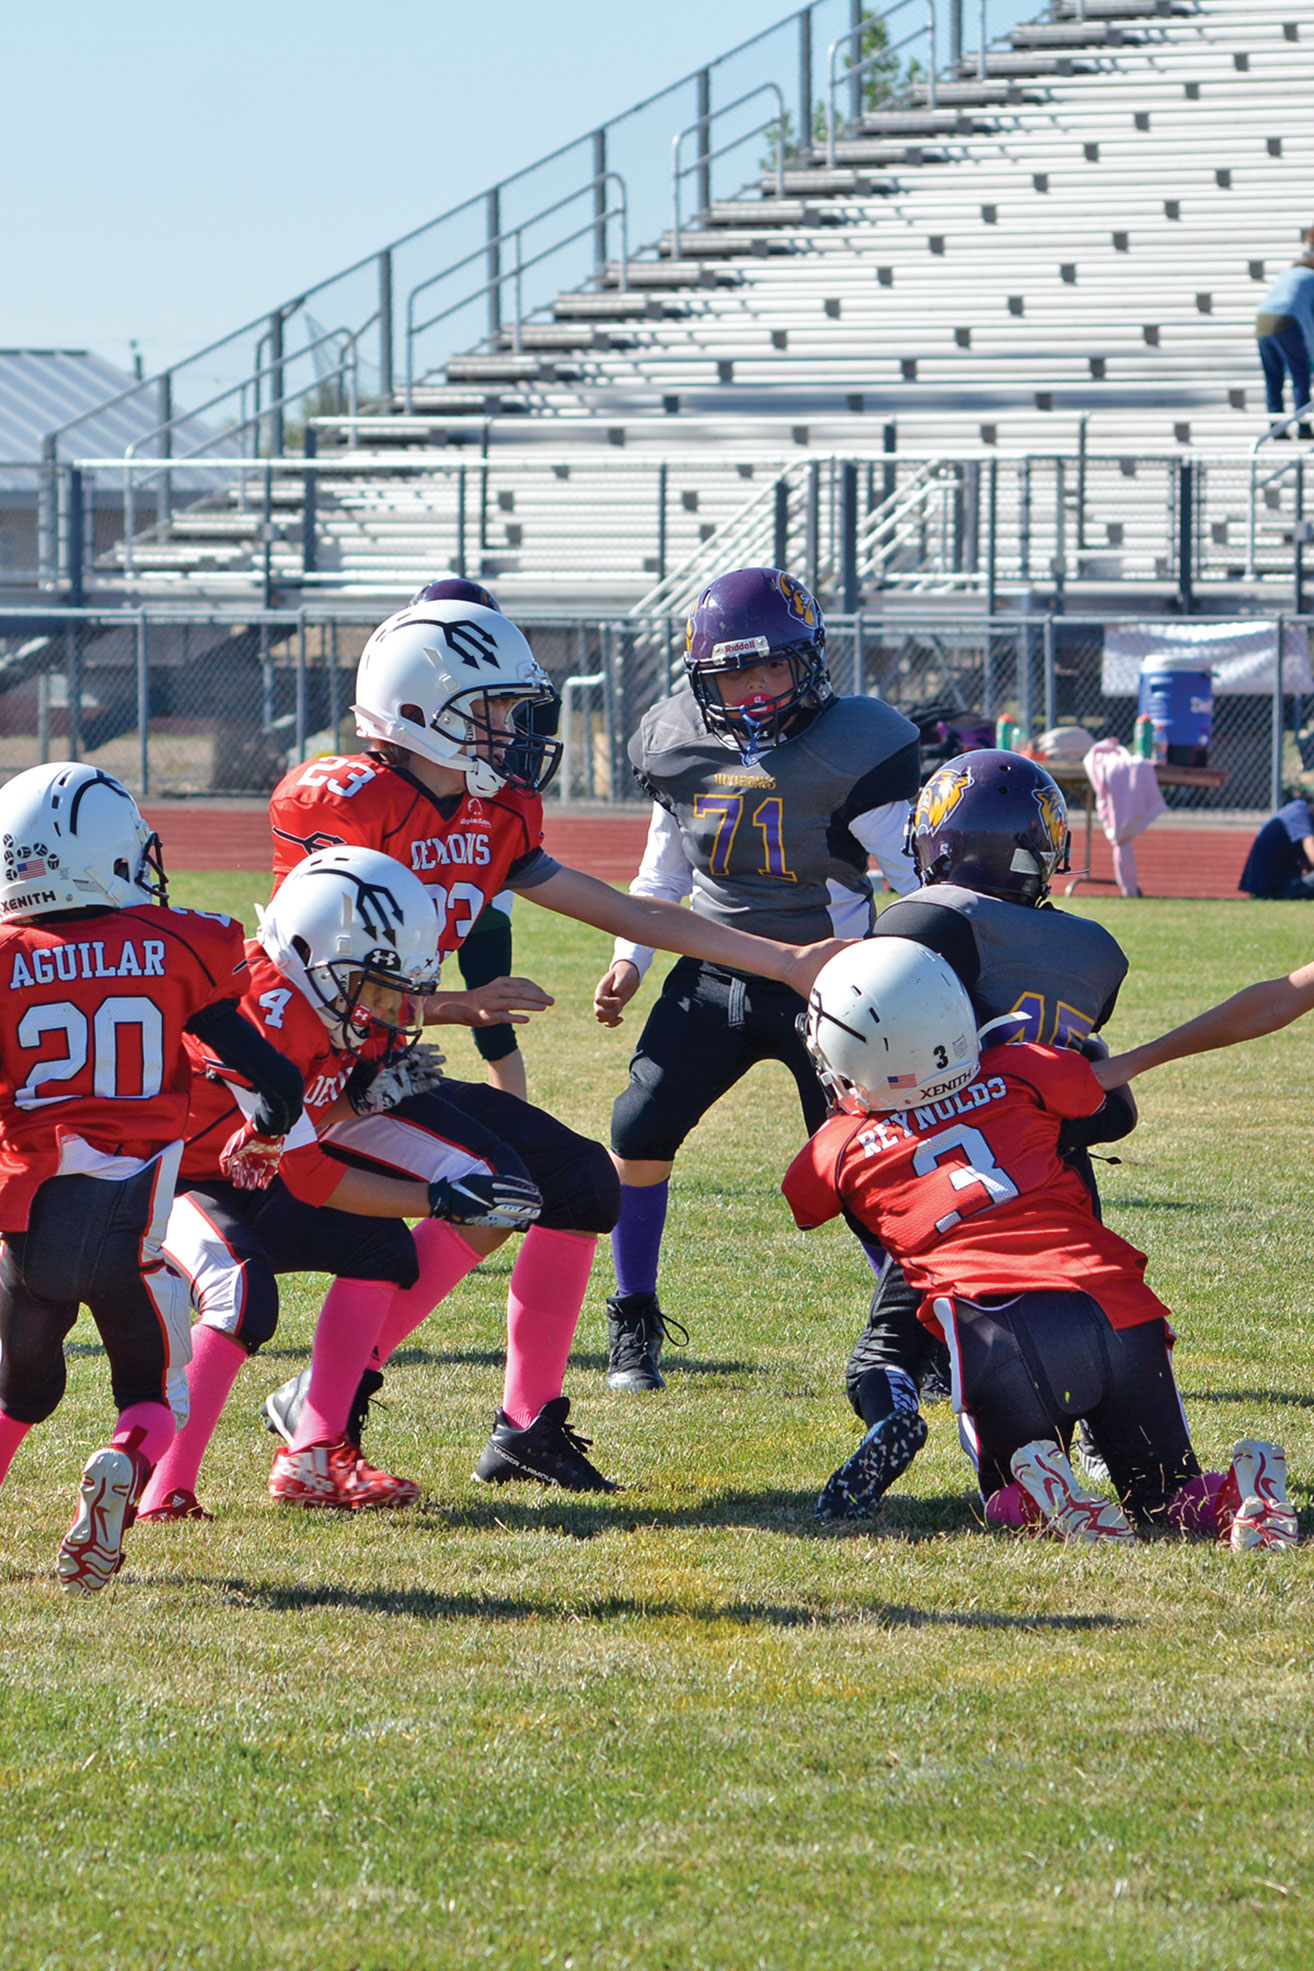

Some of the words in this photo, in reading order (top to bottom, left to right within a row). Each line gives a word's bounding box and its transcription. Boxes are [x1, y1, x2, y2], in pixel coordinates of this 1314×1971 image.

[725, 640, 756, 653] Riddell
[296, 756, 376, 798] 23
[411, 832, 491, 870] DEMONS
[694, 794, 798, 882] 71
[1, 890, 57, 913] XENITH
[10, 940, 165, 990] AGUILAR
[258, 989, 294, 1030] 4
[14, 995, 164, 1111] 20
[933, 1044, 949, 1070] 3
[920, 1068, 972, 1101] XENITH
[856, 1076, 1008, 1160] REYNOLDS
[912, 1122, 1019, 1234] 3
[494, 1446, 520, 1467] UNDER
